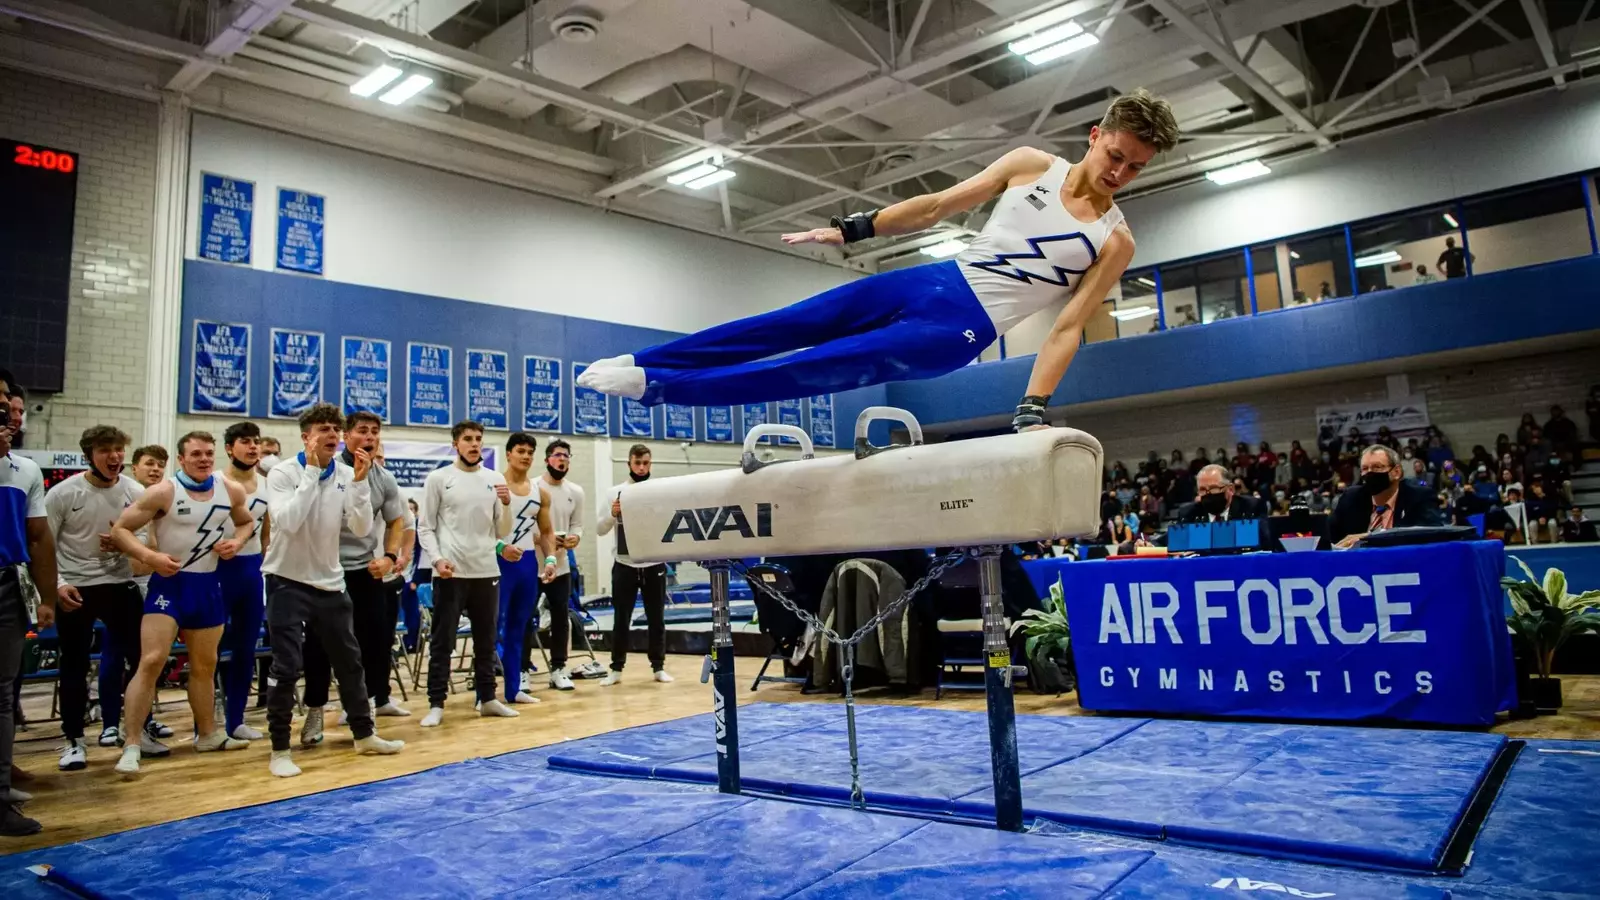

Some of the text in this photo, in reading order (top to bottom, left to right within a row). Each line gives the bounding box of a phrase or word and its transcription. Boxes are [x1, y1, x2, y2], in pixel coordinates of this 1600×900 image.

[14, 145, 74, 173] 2:00
[215, 325, 231, 336] AFA
[286, 333, 309, 347] AFA
[421, 347, 439, 359] AFA
[535, 360, 551, 370] AFA
[53, 454, 76, 466] HIGH
[1098, 572, 1427, 645] AIR FORCE
[1100, 666, 1433, 695] GYMNASTICS
